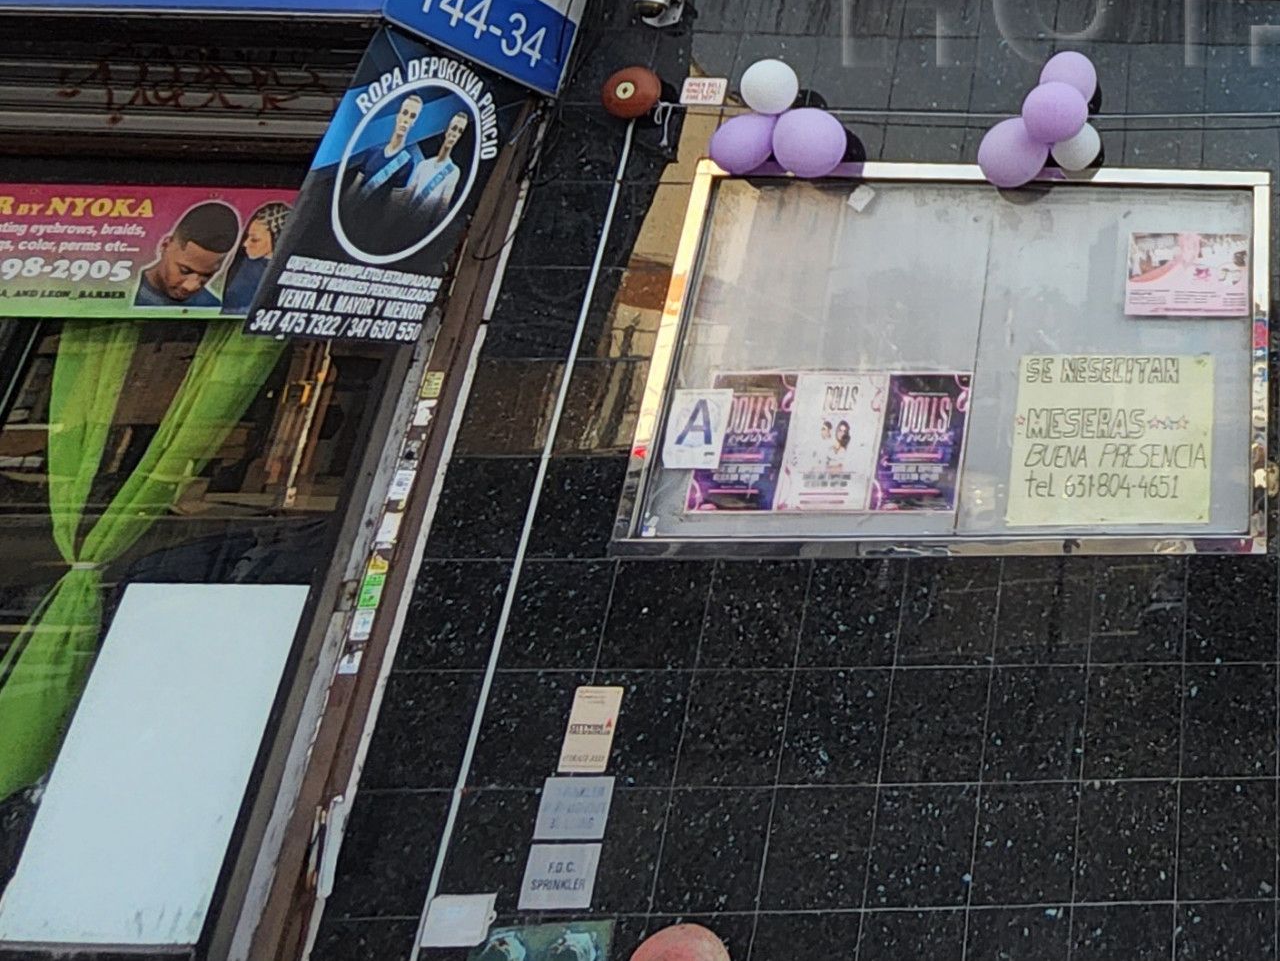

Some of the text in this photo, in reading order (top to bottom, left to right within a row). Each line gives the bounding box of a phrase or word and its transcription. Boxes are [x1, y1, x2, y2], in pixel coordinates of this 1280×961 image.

[355, 67, 403, 115] ROPA
[407, 56, 484, 102] DEPORTIVA
[478, 92, 498, 160] PONCIO
[16, 203, 45, 216] BY
[45, 197, 154, 218] NYOKA
[30, 222, 98, 237] eyebrows,
[101, 223, 146, 238] braids,
[18, 238, 57, 252] color,
[58, 241, 101, 253] perms
[320, 276, 328, 290] Y
[276, 288, 427, 321] VENTA AL MAYOR Y MENOR
[250, 309, 281, 332] 347
[279, 311, 308, 334] 475
[305, 313, 341, 336] 7322
[347, 317, 373, 338] 347
[369, 319, 397, 340] 630
[1026, 357, 1055, 384] SE
[823, 385, 859, 412] DOLLS
[674, 399, 713, 446] A
[900, 396, 952, 434] DOLLS
[1026, 407, 1146, 439] MESERAS
[1024, 442, 1207, 469] BUENA PRESENCIA
[1024, 470, 1056, 498] tel
[530, 878, 586, 890] SPRINKLER
